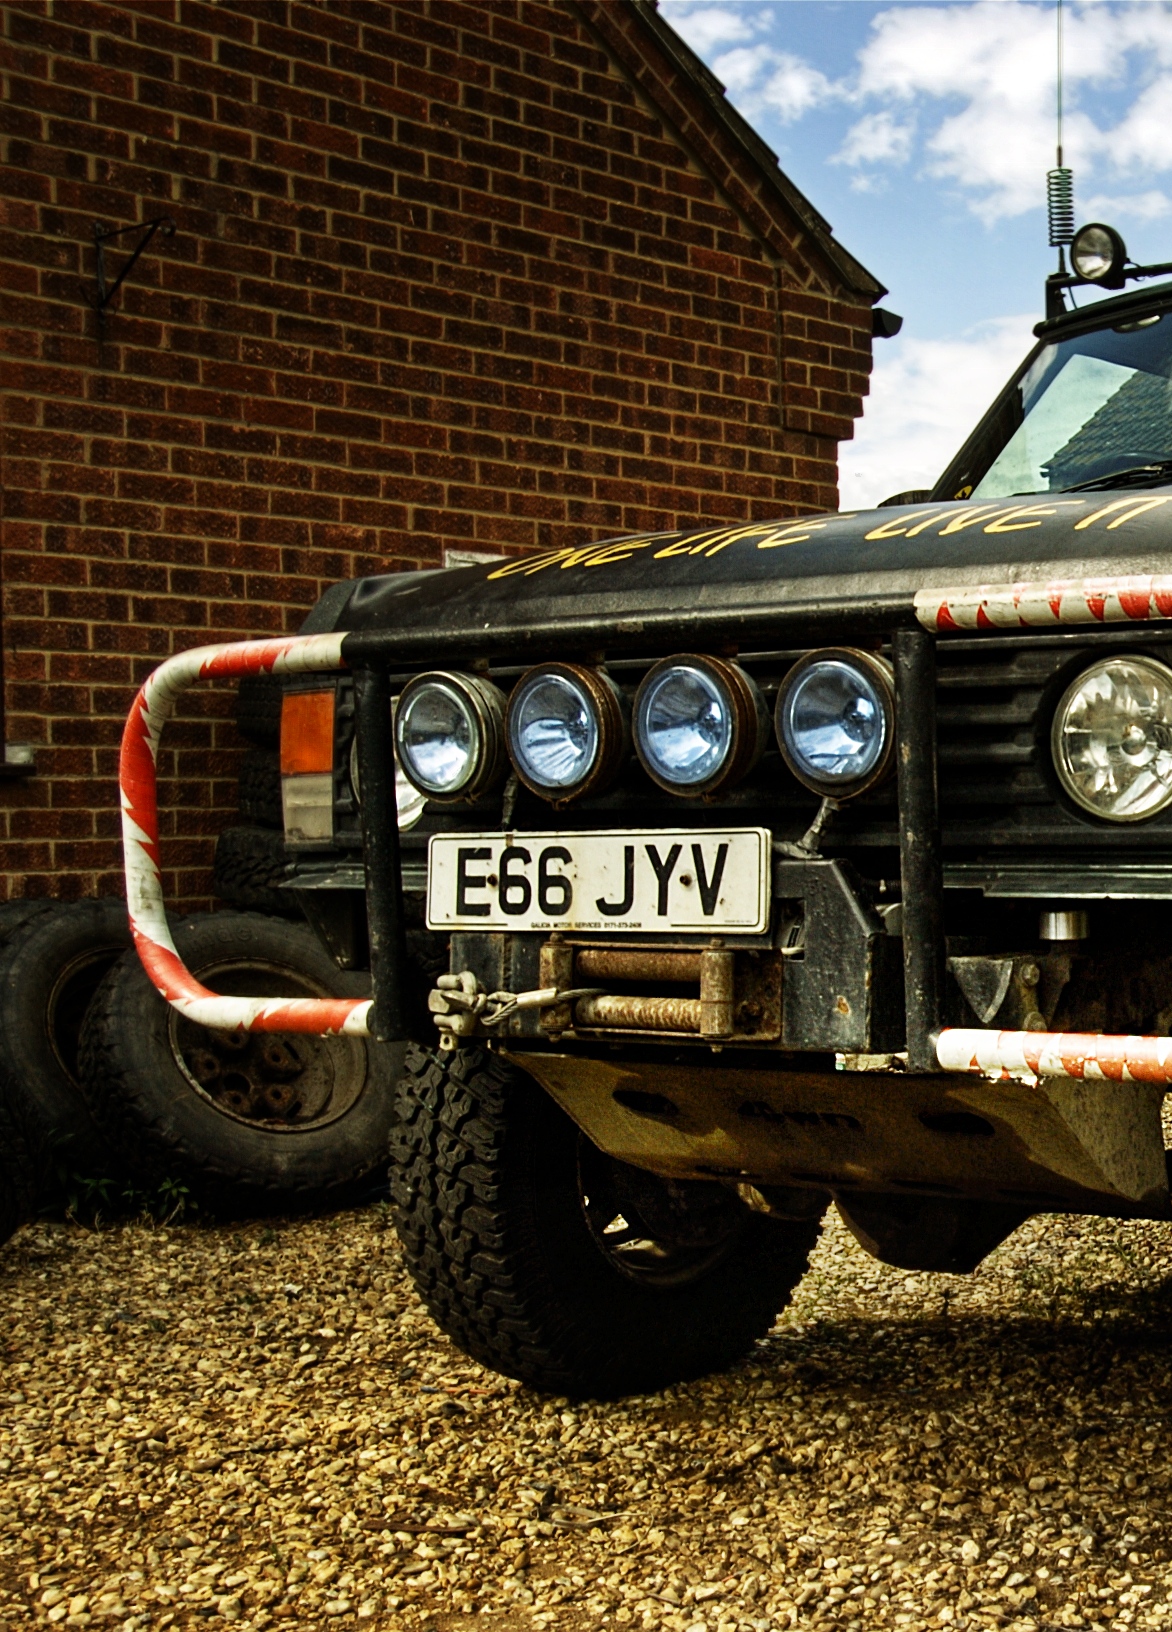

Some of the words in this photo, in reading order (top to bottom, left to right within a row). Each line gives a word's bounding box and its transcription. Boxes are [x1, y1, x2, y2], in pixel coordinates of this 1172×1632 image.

[487, 533, 682, 580] ONE
[653, 514, 858, 559] LIFE
[864, 500, 1086, 540] LIVE
[455, 846, 573, 917] E66
[595, 843, 730, 917] JYV
